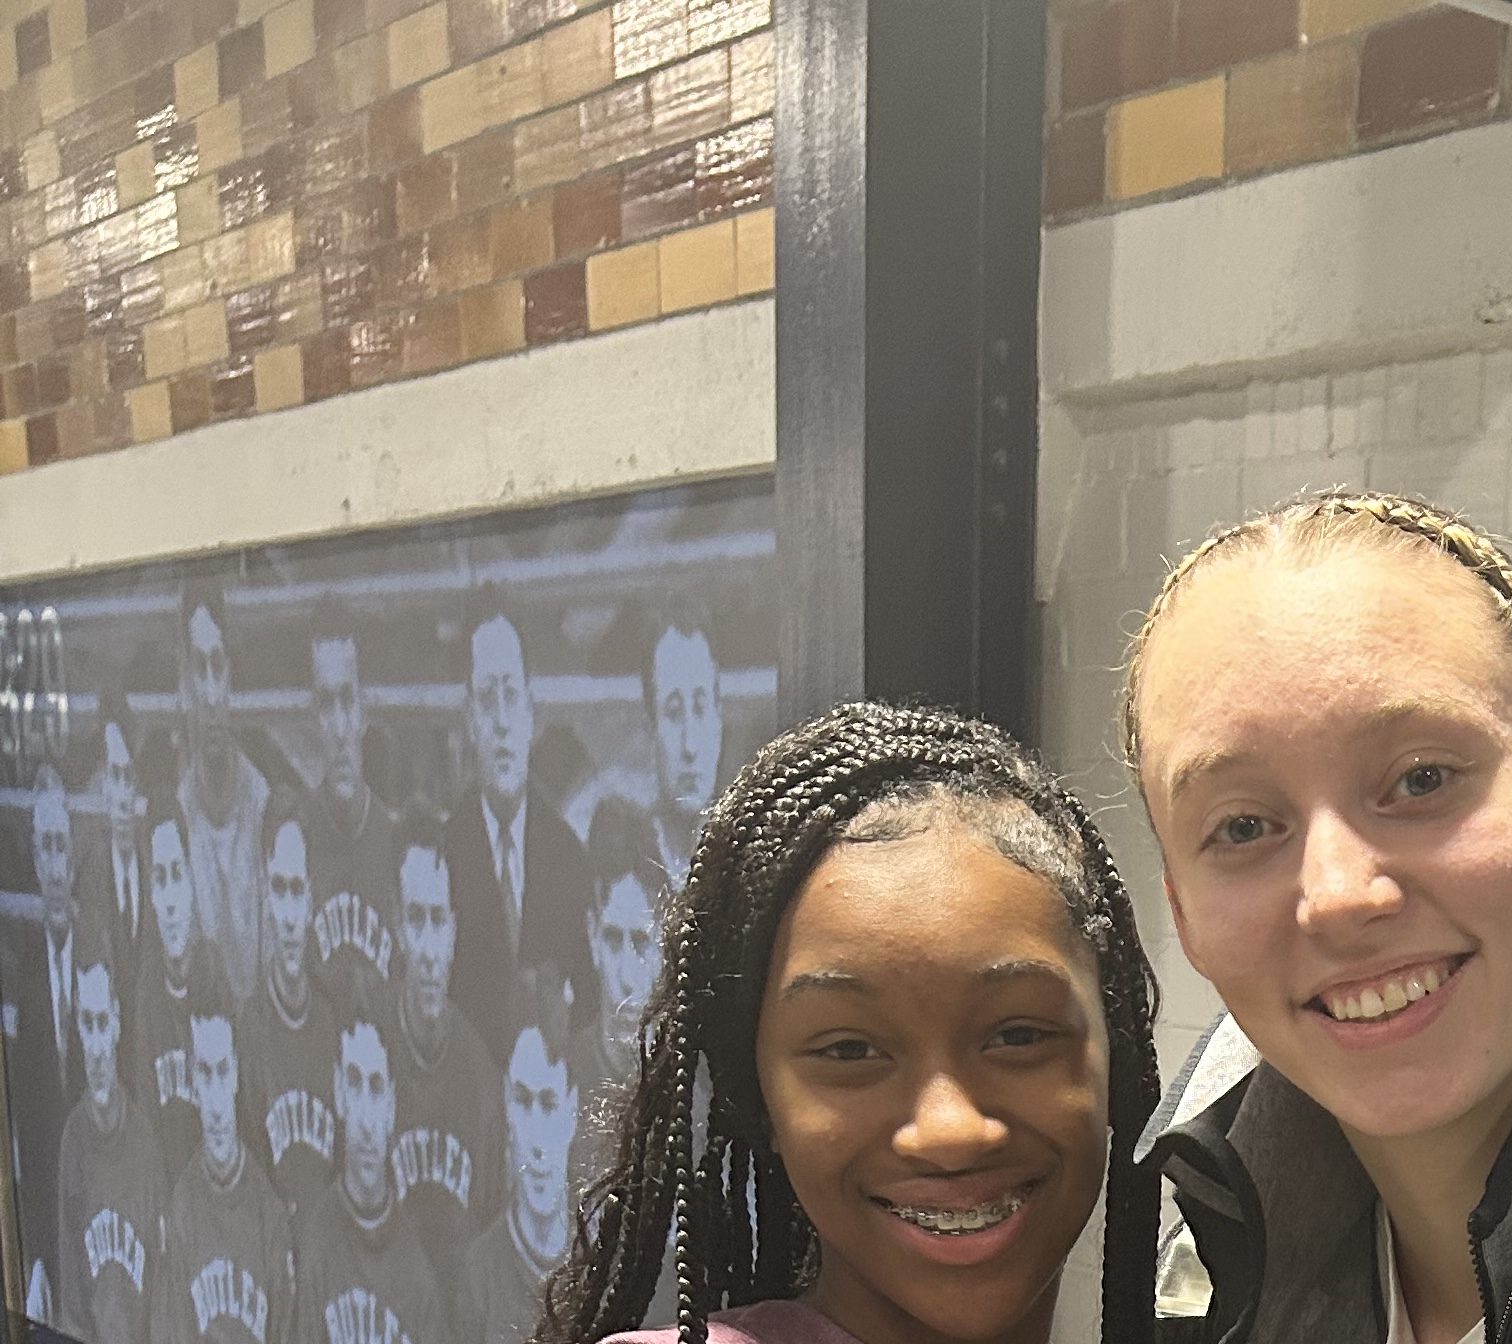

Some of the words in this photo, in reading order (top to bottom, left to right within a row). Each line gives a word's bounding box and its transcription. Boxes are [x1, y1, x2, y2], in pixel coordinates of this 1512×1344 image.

[314, 891, 393, 980] BUTLER
[154, 1048, 200, 1105] BUTL
[265, 1088, 334, 1165] BUTLER
[391, 1127, 472, 1209] BUTLER
[84, 1208, 145, 1294] BUTLER
[191, 1256, 268, 1344] BUTLER
